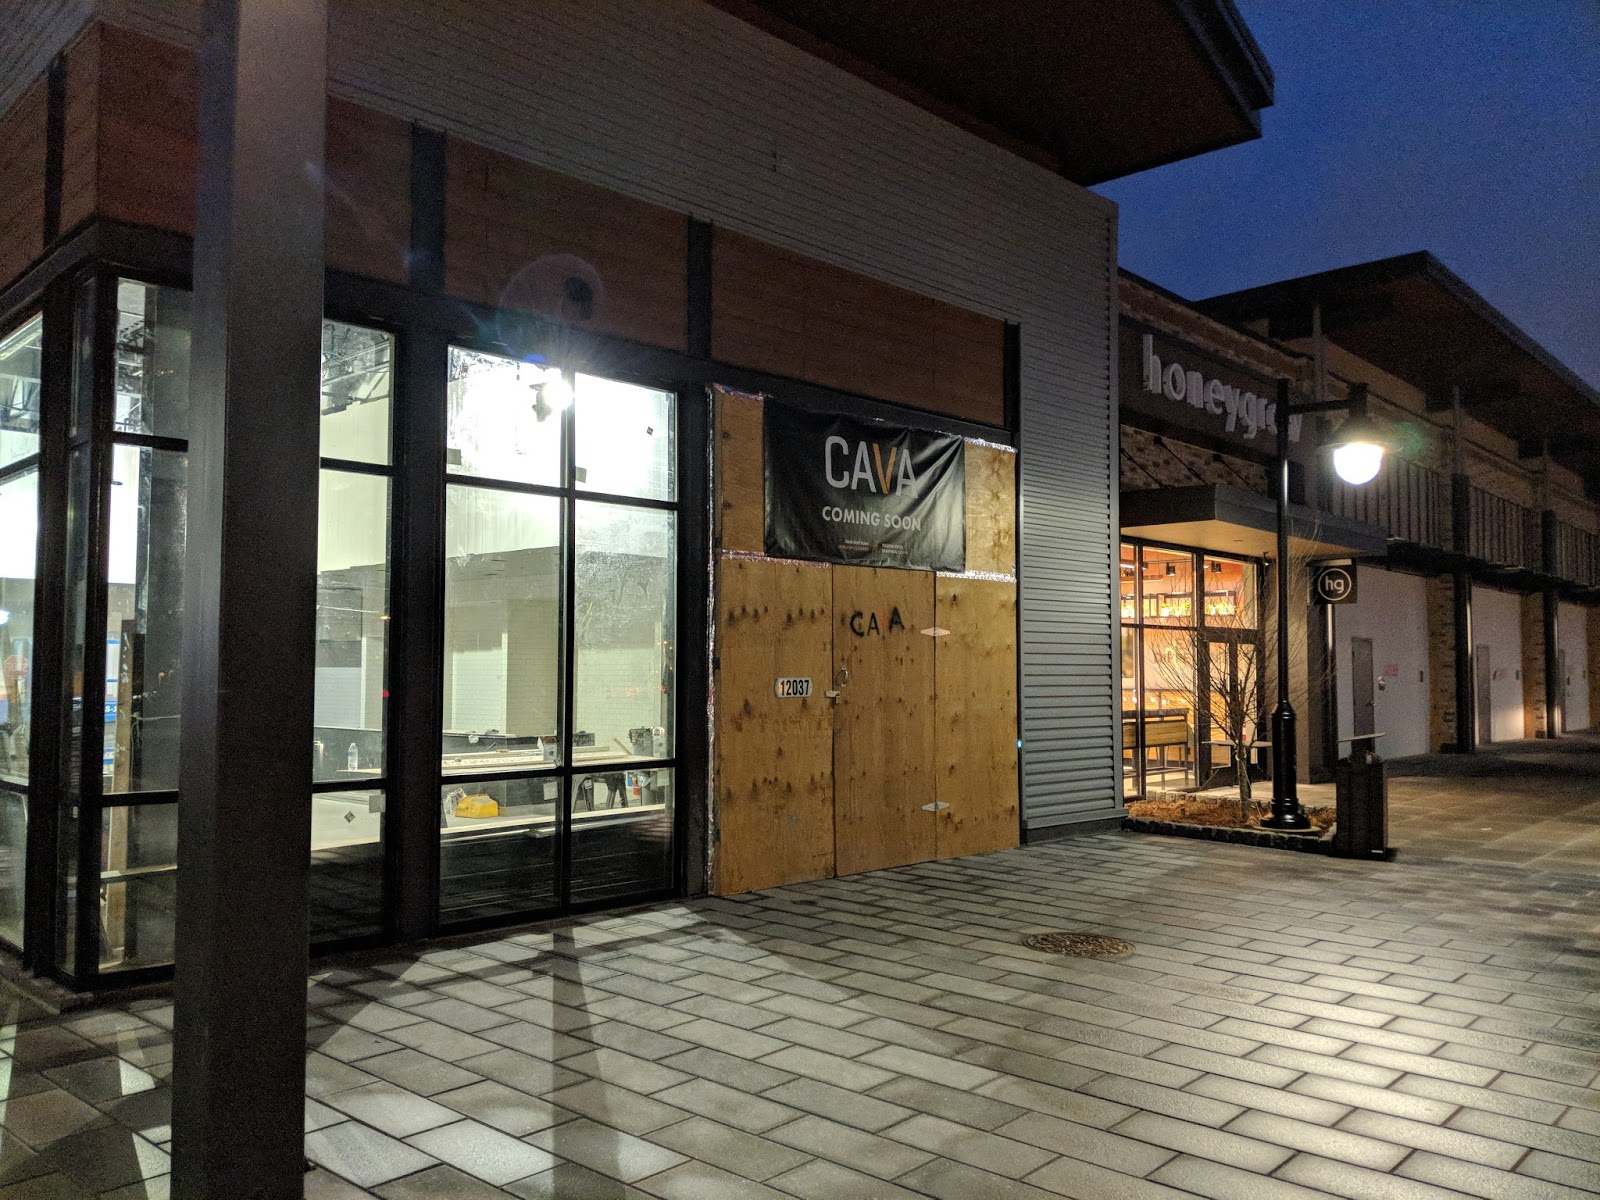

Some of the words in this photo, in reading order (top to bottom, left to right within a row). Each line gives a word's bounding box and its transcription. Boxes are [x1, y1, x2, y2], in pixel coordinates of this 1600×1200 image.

[824, 435, 919, 499] CAVA
[822, 506, 881, 527] COMING
[883, 513, 921, 531] SOON
[1325, 576, 1345, 594] hg
[779, 679, 810, 696] 12037
